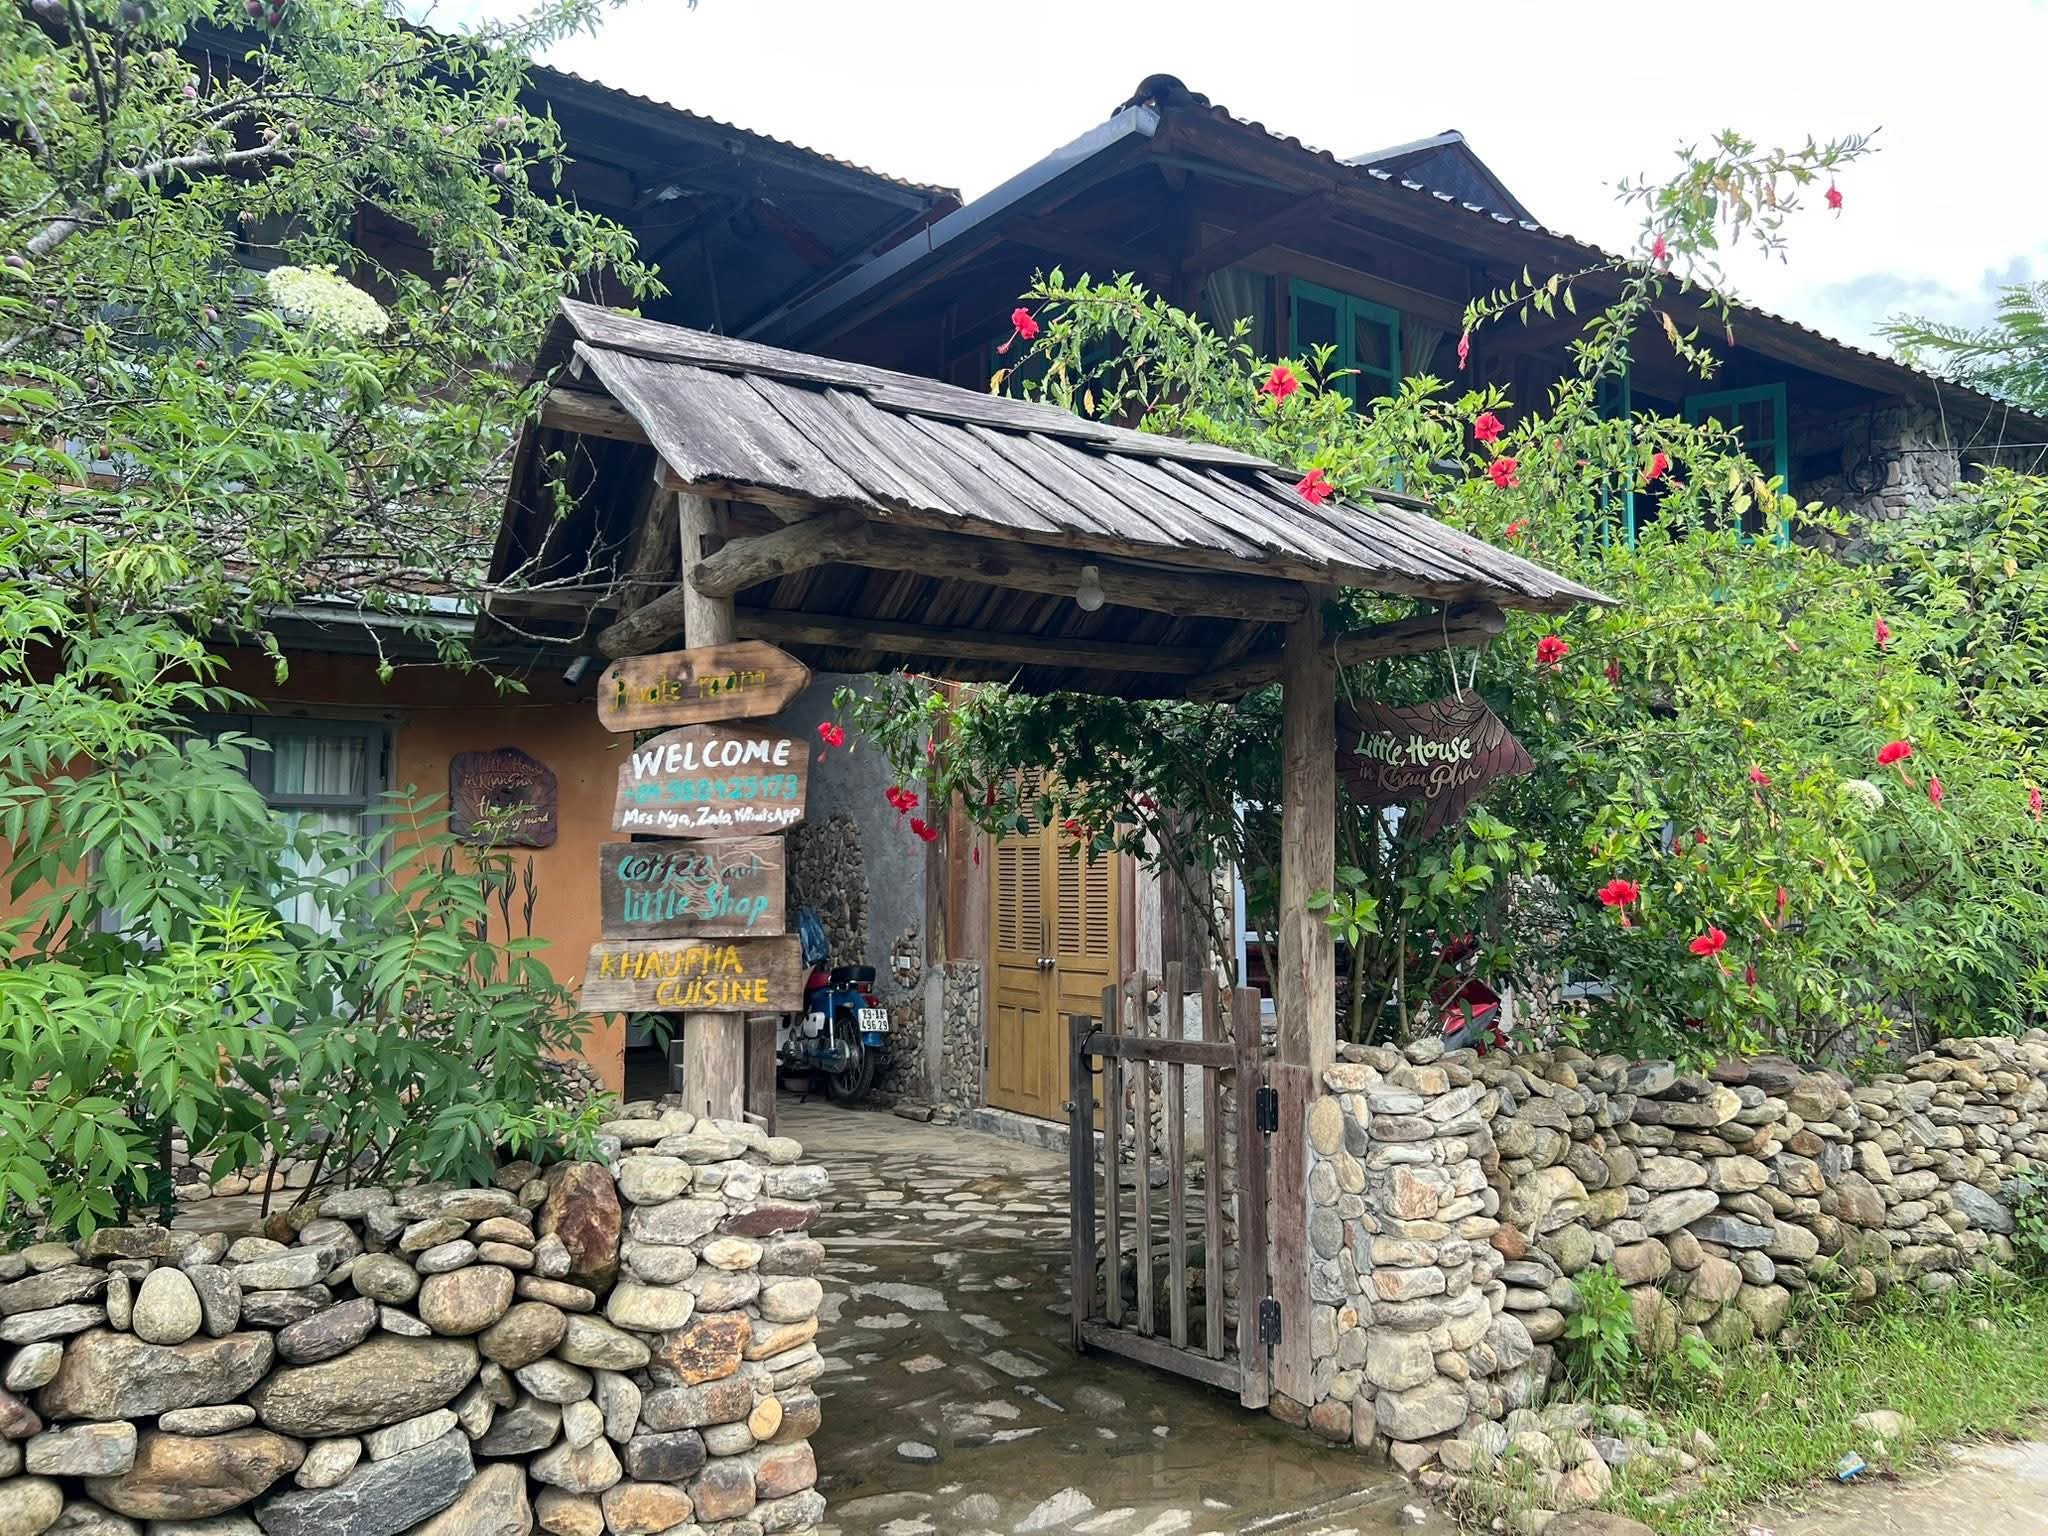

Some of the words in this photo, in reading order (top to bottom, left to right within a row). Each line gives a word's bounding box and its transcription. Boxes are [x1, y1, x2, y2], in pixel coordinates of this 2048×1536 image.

[632, 739, 792, 780] WELCOME
[1354, 731, 1406, 766] Little
[1407, 735, 1473, 767] House
[1360, 761, 1376, 780] in
[656, 809, 696, 829] Nga,
[698, 882, 768, 927] Shop
[655, 976, 769, 1008] CUISINE
